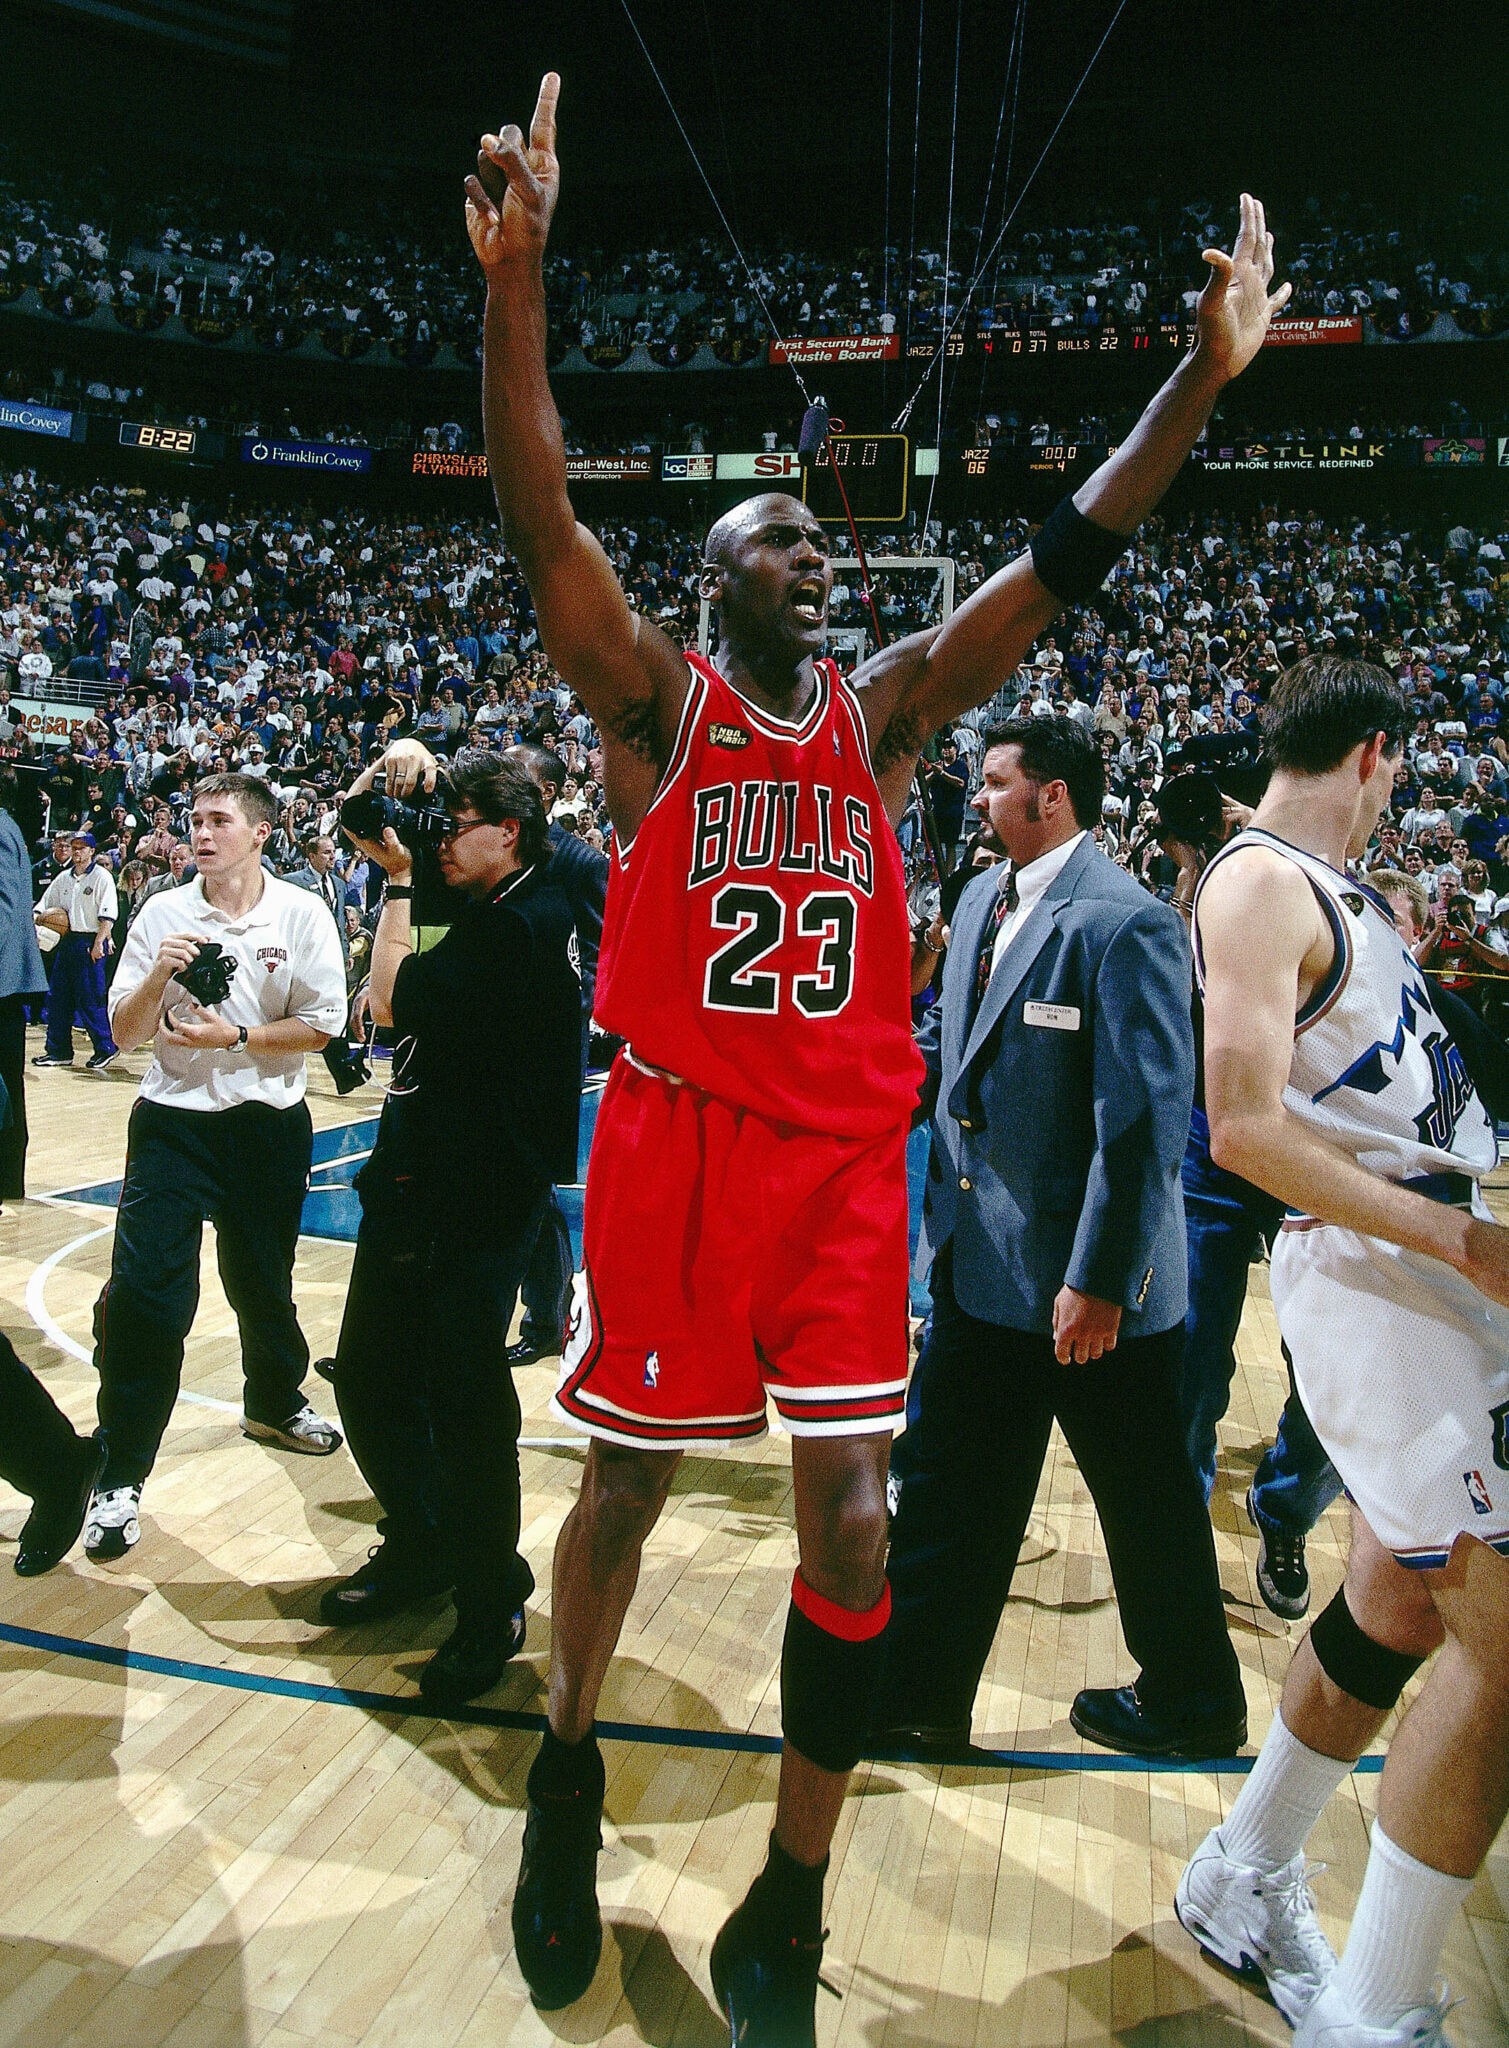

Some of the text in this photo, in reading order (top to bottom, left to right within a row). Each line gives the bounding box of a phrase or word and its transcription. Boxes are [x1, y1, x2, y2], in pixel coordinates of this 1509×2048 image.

[1318, 318, 1353, 328] Bank
[775, 337, 891, 350] First Security Bank
[906, 340, 1047, 357] JAZZ 33 4 0 37
[1057, 340, 1090, 351] BULLS
[1100, 337, 1118, 350] 22
[1134, 336, 1149, 349] 11
[1169, 334, 1179, 347] 4
[787, 349, 882, 362] Hustle Board
[138, 427, 193, 451] 8:22
[272, 447, 362, 471] FranklinCovey
[413, 453, 488, 466] CHRYSLER
[961, 450, 990, 460] JAZZ
[412, 463, 488, 477] PLYMOUTH
[630, 460, 651, 469] Inc.
[1057, 461, 1065, 472] 4
[1203, 462, 1231, 470] YOUR
[1235, 461, 1270, 469] PHONE
[1319, 459, 1374, 469] REDEFINED
[718, 726, 741, 738] NBA
[687, 780, 874, 899] BULLS
[256, 947, 288, 962] CHICAGO
[703, 882, 858, 1018] 23
